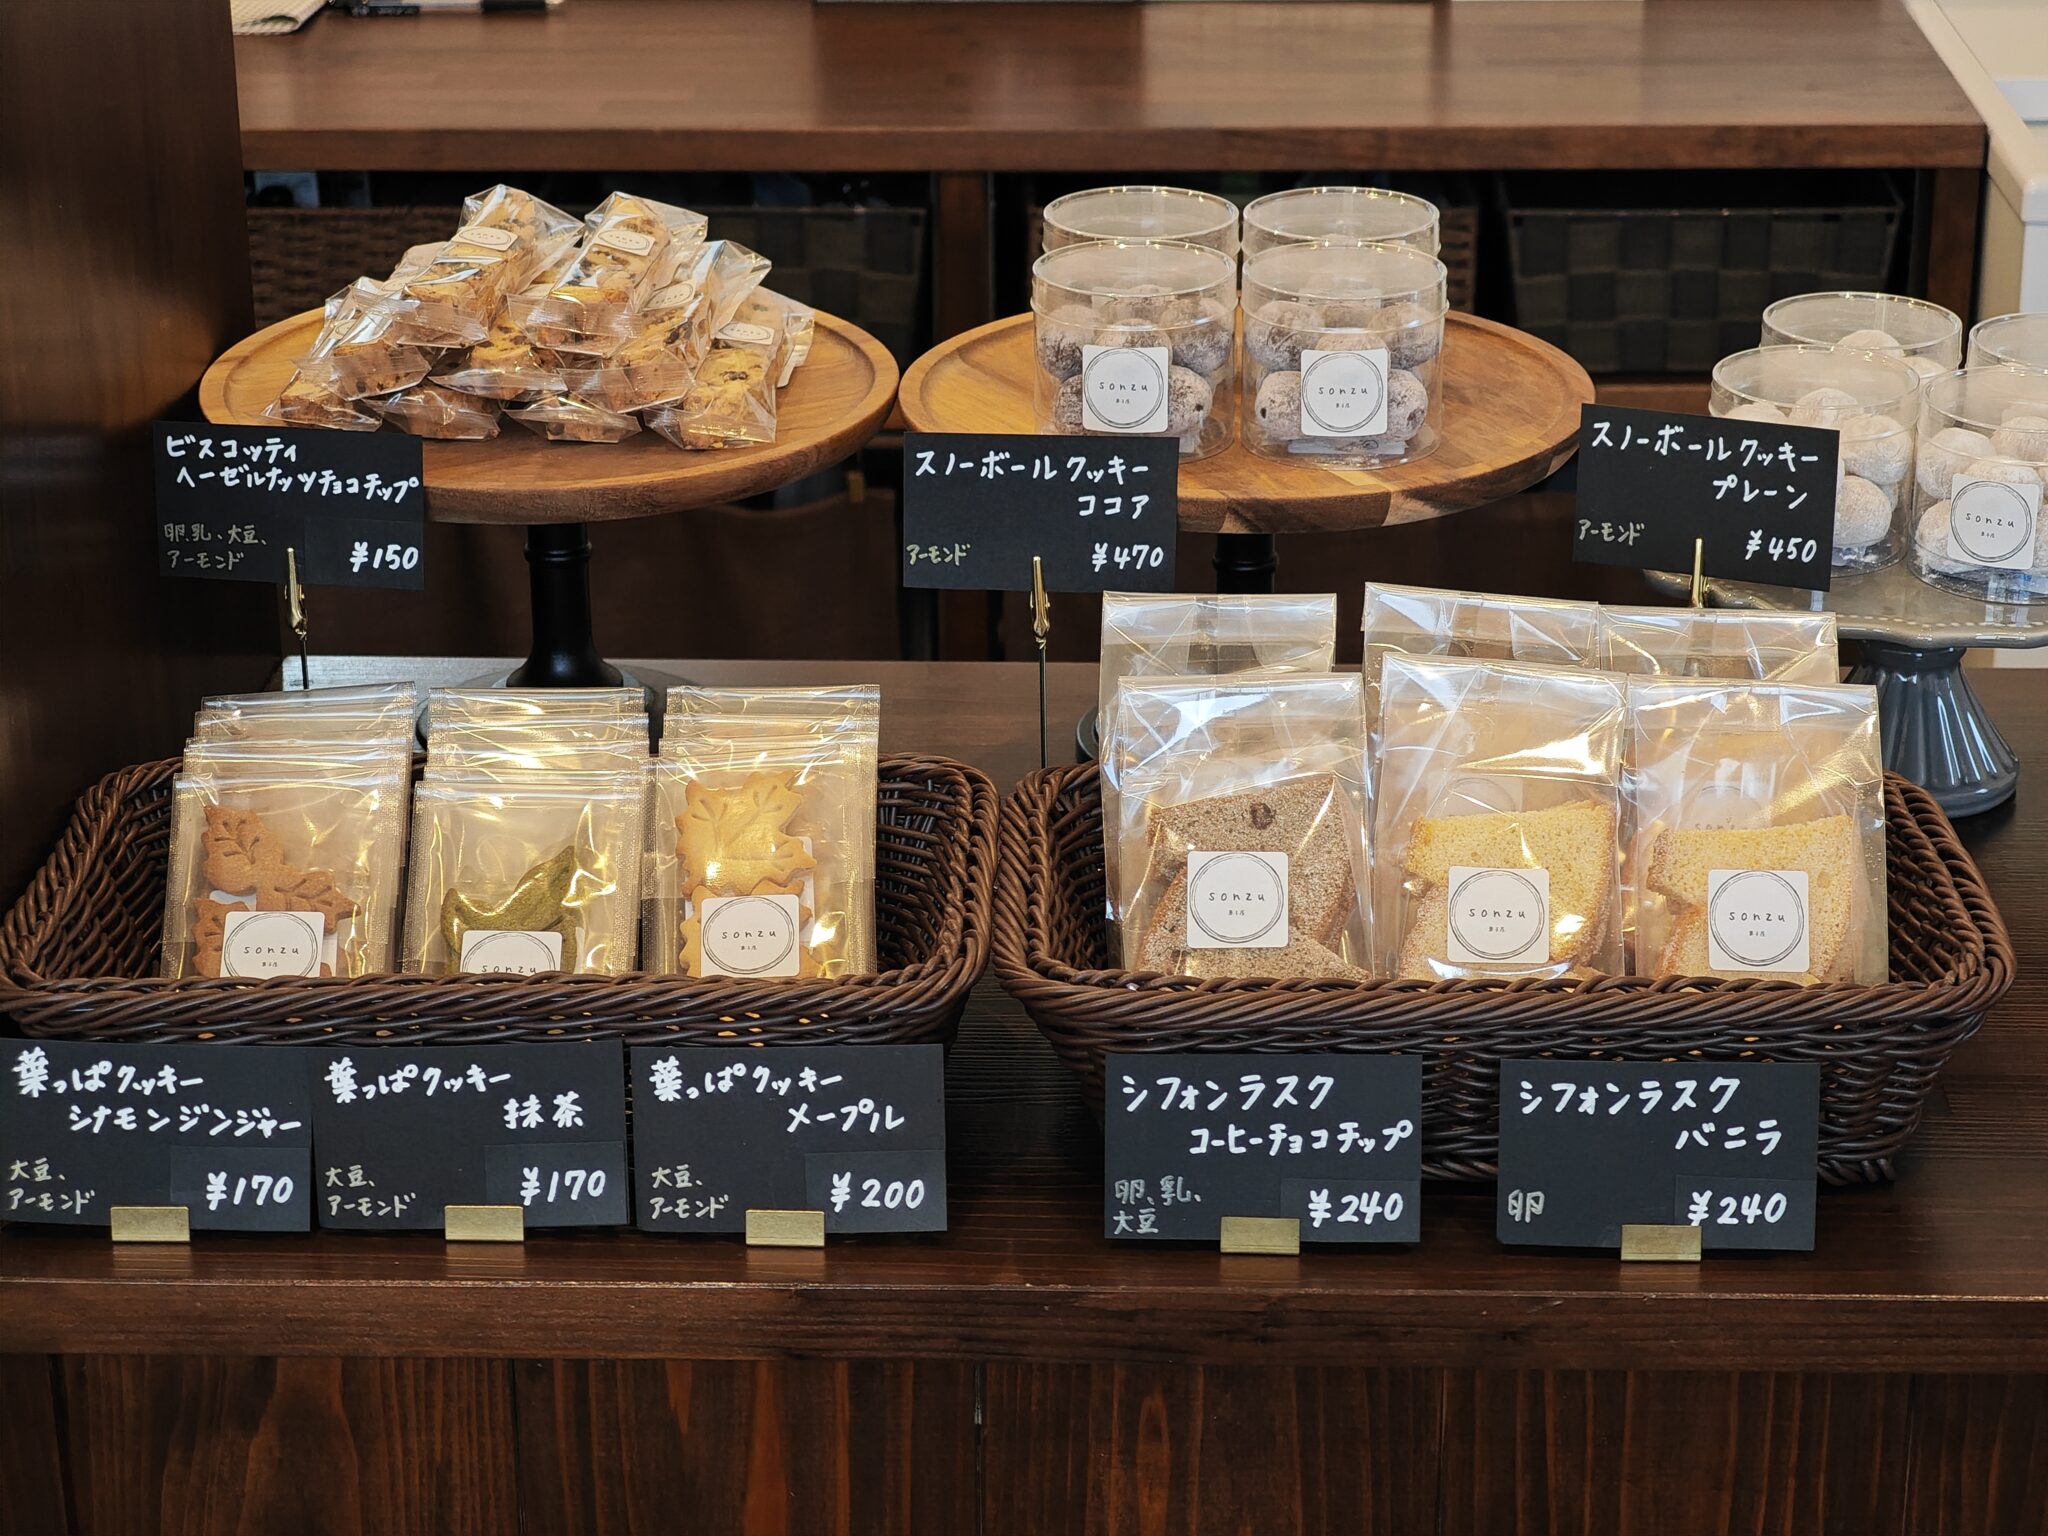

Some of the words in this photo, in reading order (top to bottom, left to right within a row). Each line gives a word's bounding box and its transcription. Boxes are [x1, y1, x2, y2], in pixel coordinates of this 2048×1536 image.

[1099, 381, 1149, 392] sonzu
[1318, 386, 1369, 396] sonzu
[166, 434, 297, 464] ビスコッティ
[176, 464, 419, 503] ヘーゼルナッツチョコチップ
[1712, 474, 1808, 509] プレーン
[1078, 495, 1149, 519] ココア
[1965, 513, 2014, 528] sonzu
[1578, 519, 1645, 546] アーモンド
[1745, 529, 1817, 563] ¥450
[166, 549, 244, 571] アーモンド
[349, 541, 419, 572] ¥150
[906, 543, 971, 566] アーモンド
[1091, 542, 1164, 572] ¥470
[1209, 892, 1265, 901] sonzu
[1469, 909, 1526, 919] sonzu
[1729, 912, 1785, 922] sonzu
[243, 946, 299, 954] sonzu
[722, 930, 777, 939] sonzu
[481, 965, 537, 974] sonzu
[12, 1046, 204, 1098] 葉っぱクッキー
[324, 1057, 512, 1104] 葉っぱクッキー
[649, 1055, 843, 1102] 葉っぱクッキー
[1122, 1074, 1335, 1113] シフォンラスク
[1519, 1076, 1741, 1115] シフォンラスク
[69, 1103, 302, 1138] シナモンジンジャー
[503, 1090, 585, 1129] 抹茶
[787, 1098, 905, 1133] メープル
[1189, 1119, 1413, 1156] コーヒーチョコチップ
[1675, 1119, 1782, 1156] バニラ
[8, 1188, 96, 1215] アーモンド
[205, 1171, 294, 1211] ¥170
[520, 1166, 606, 1206] ¥170
[831, 1171, 925, 1213] ¥200
[327, 1192, 416, 1218] アーモンド
[649, 1194, 729, 1220] アーモンド
[1308, 1188, 1404, 1229] ¥240
[1508, 1189, 1545, 1223] 卵
[1687, 1190, 1787, 1226] ¥240
[1112, 1208, 1160, 1235] 大豆
